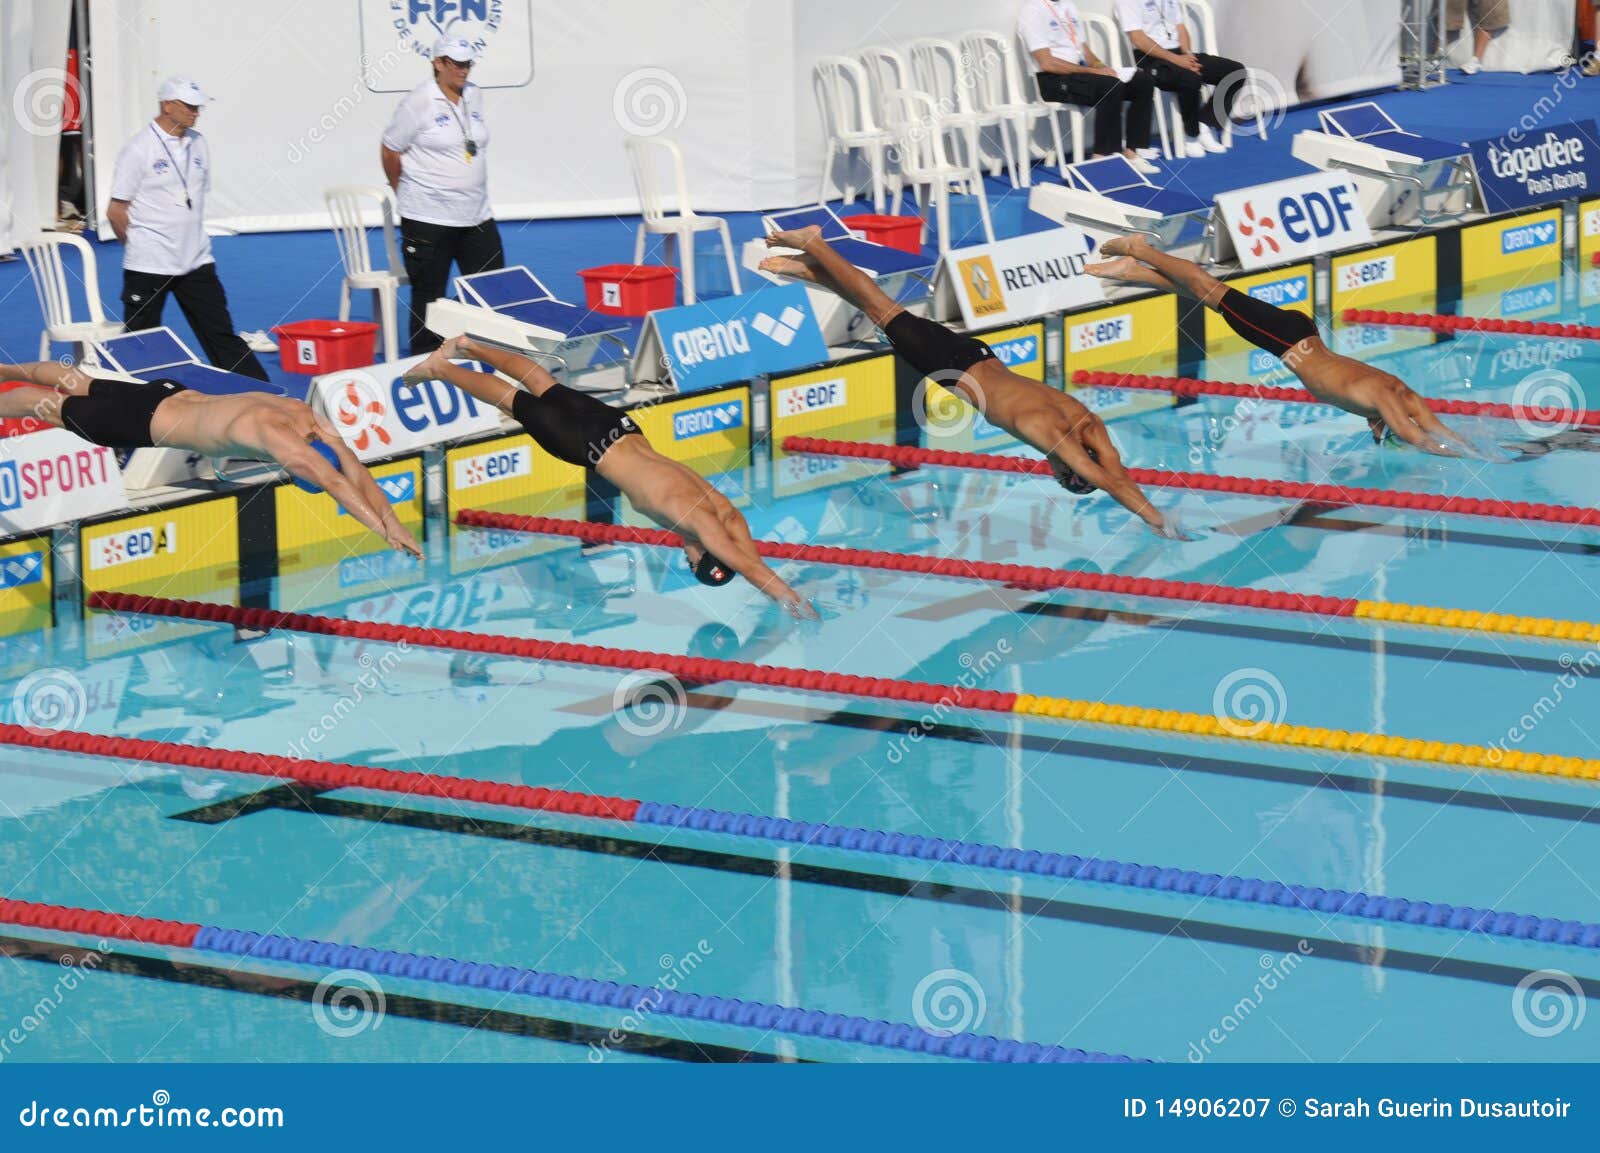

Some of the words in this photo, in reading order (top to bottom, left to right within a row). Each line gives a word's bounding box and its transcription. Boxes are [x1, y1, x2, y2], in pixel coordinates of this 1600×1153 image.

[1001, 252, 1089, 291] RENAULT
[606, 288, 616, 303] 7
[302, 348, 313, 361] 6
[672, 318, 751, 367] arena
[675, 411, 714, 436] arena
